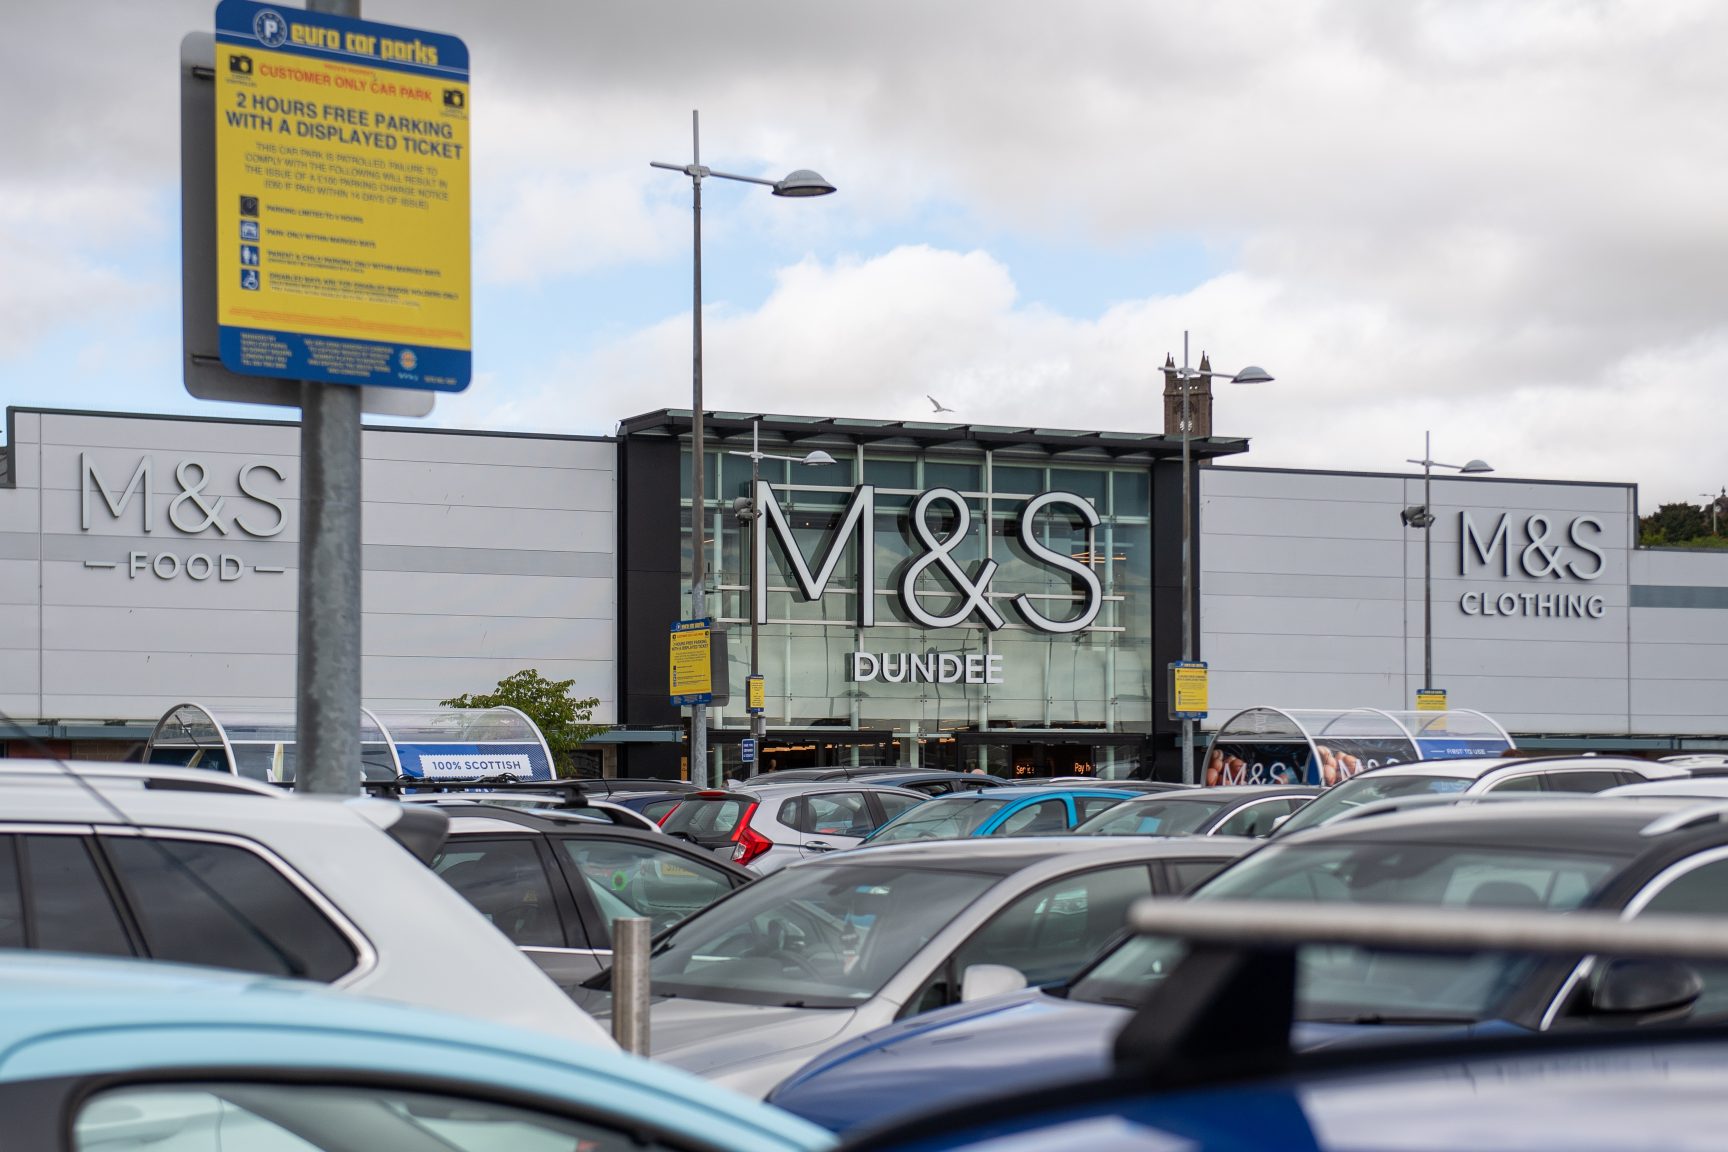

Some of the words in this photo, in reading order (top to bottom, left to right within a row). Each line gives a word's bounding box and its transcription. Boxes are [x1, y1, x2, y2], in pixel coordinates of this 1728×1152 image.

[291, 22, 340, 49] euro
[346, 31, 376, 56] car
[381, 37, 438, 66] parks
[259, 63, 330, 86] CUSTOMER
[335, 75, 368, 93] ONLY
[371, 80, 396, 97] CAR
[400, 86, 432, 102] PARK
[236, 91, 245, 108] 2
[252, 93, 317, 119] HOURS
[323, 105, 368, 127] FREE
[374, 113, 452, 139] PARKING
[226, 110, 272, 132] WITH
[278, 118, 291, 135] A
[297, 121, 396, 150] DISPLAYED
[403, 136, 462, 160] TICKET
[246, 152, 279, 165] COMPLY
[285, 158, 307, 169] WITH
[309, 161, 325, 171] THE
[329, 164, 379, 179] FOLLOWING
[383, 171, 402, 182] WILL
[405, 174, 436, 186] RESULT
[301, 148, 321, 159] PARK
[246, 165, 262, 175] THE
[340, 177, 376, 190] PARKING
[418, 187, 447, 199] NOTICE
[80, 451, 288, 538] M&S
[753, 480, 1102, 633] M&S
[1460, 510, 1606, 581] M&S
[129, 551, 246, 582] FOOD
[1460, 591, 1606, 618] CLOTHING
[853, 652, 1004, 685] DUNDEE
[432, 761, 462, 770] 100%
[465, 761, 521, 770] SCOTTISH
[1074, 763, 1084, 774] Pay
[1222, 762, 1287, 786] M&S
